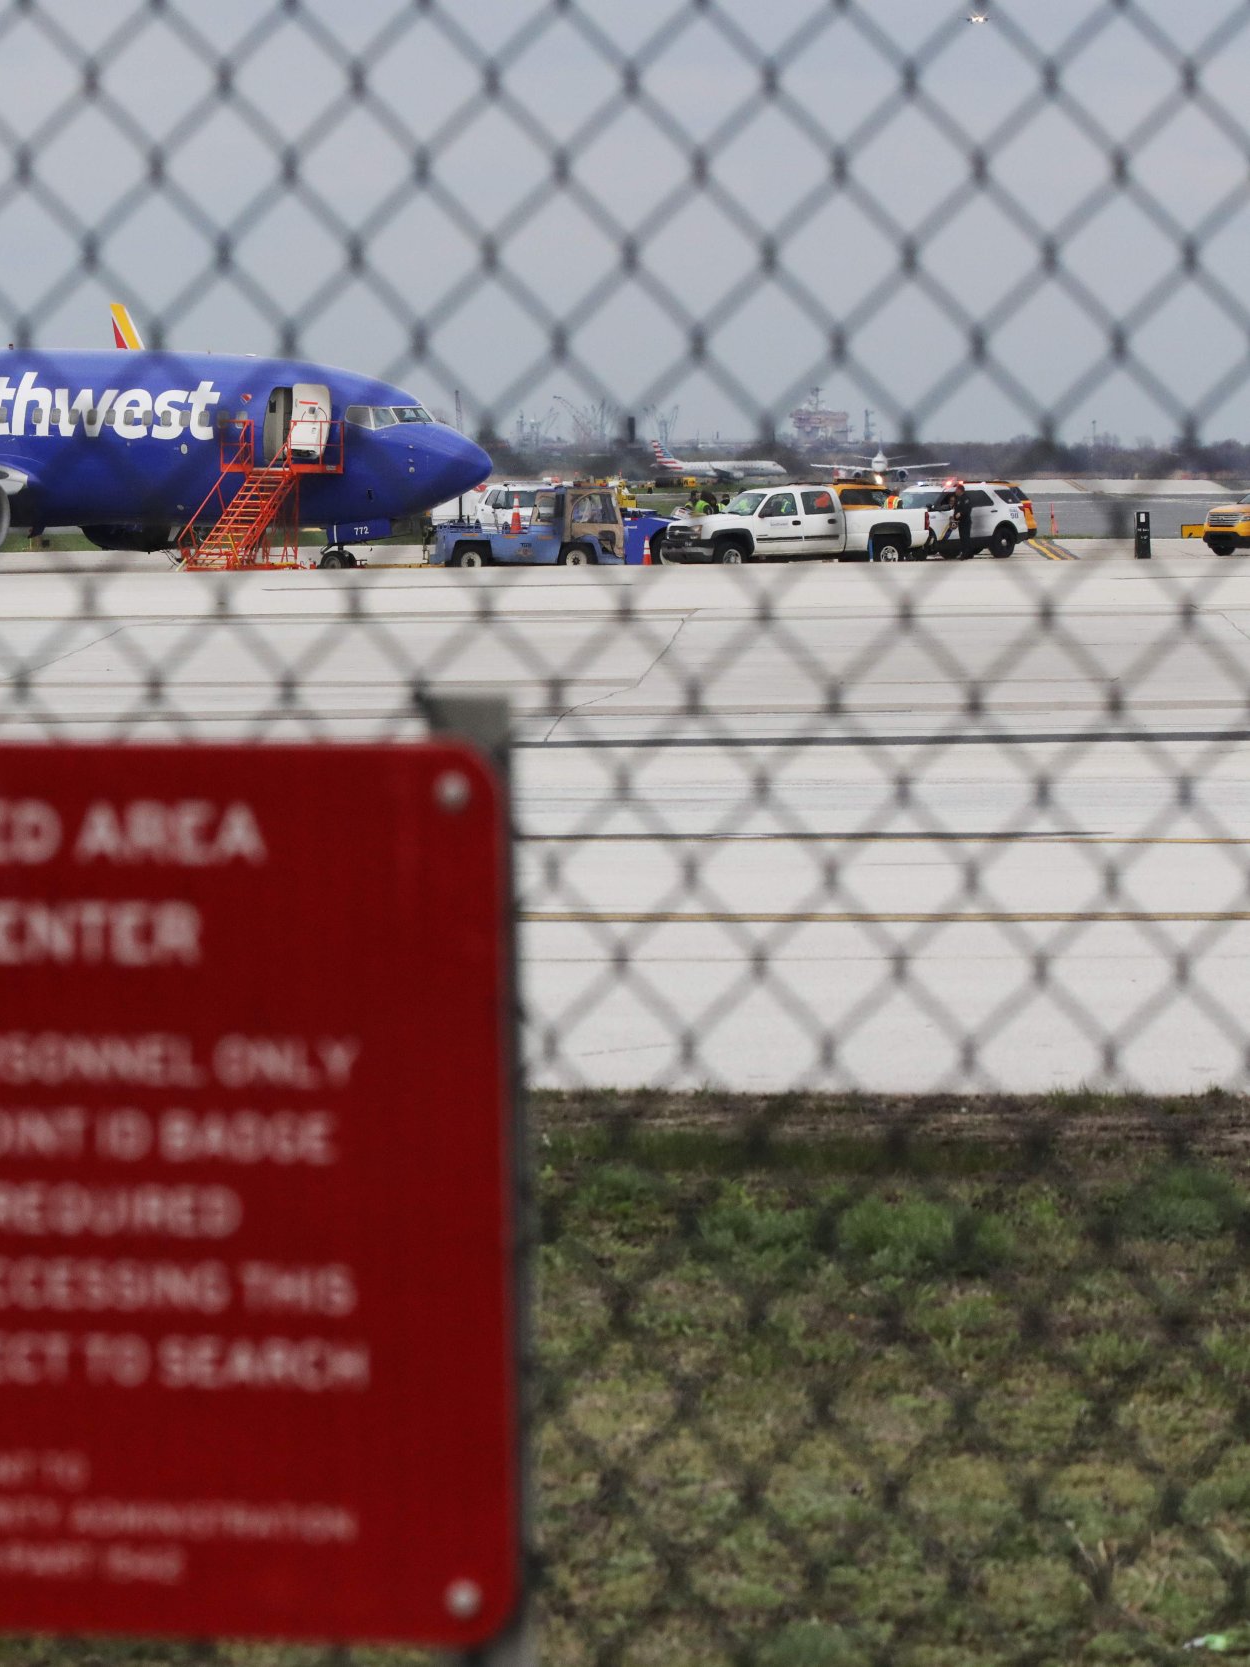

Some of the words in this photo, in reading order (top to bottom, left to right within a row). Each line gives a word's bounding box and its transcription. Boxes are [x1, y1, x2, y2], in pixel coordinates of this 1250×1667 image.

[354, 526, 370, 535] 772
[76, 799, 265, 866] AREA
[214, 1034, 358, 1089] ONLY
[95, 1108, 154, 1161] ID
[158, 1109, 334, 1165] BADGE
[239, 1260, 357, 1317] THIS
[81, 1331, 152, 1388] TO
[158, 1334, 370, 1392] SEARCH
